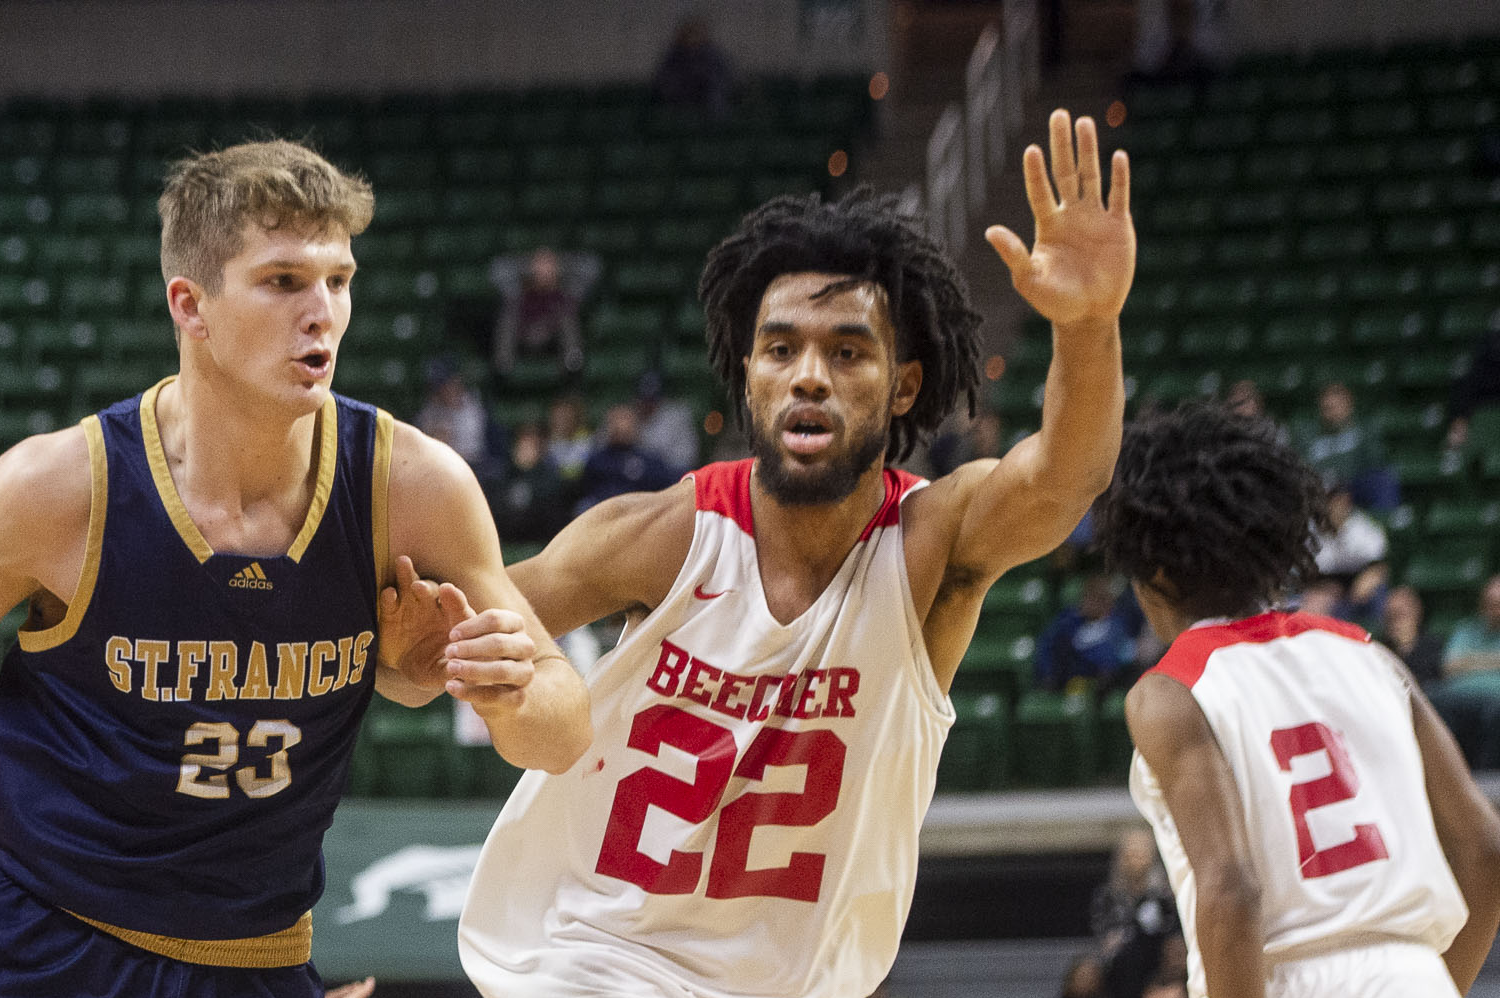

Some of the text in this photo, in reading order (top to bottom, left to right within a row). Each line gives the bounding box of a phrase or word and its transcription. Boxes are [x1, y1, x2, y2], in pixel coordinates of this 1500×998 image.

[229, 578, 274, 590] adidas
[175, 718, 302, 799] 23
[595, 704, 848, 904] 22
[1269, 721, 1390, 879] 2
